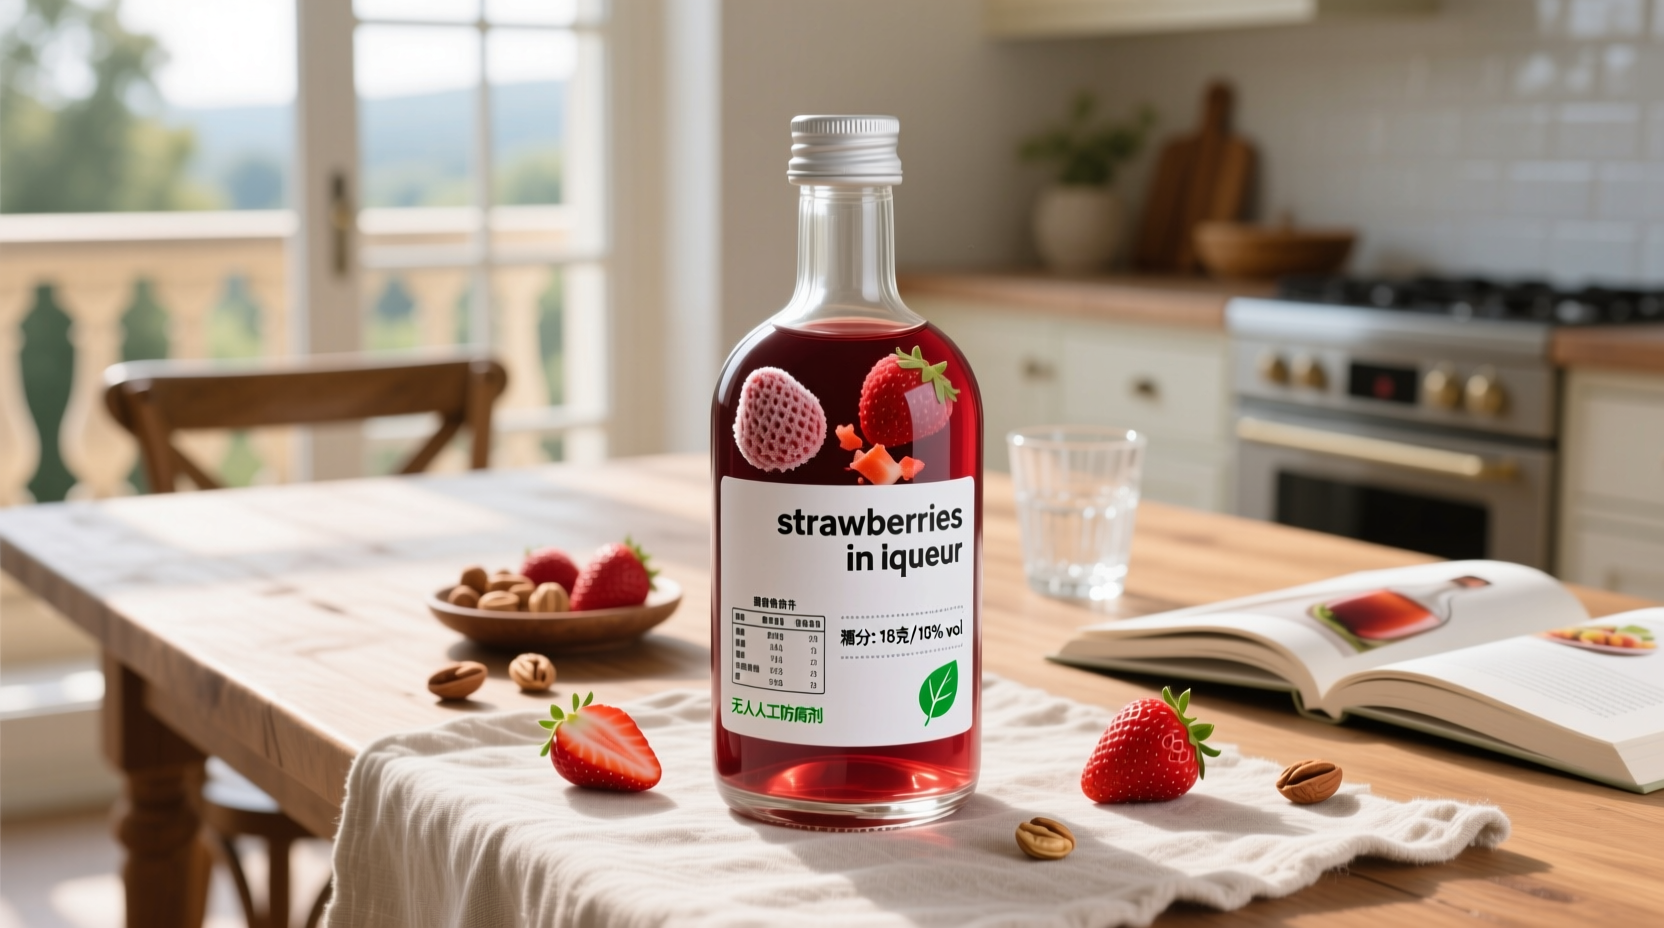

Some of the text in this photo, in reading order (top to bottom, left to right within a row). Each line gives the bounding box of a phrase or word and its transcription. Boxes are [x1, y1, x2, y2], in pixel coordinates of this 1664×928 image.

[777, 503, 963, 536] strawberries
[847, 542, 963, 578] in iqueur
[946, 619, 963, 638] vol
